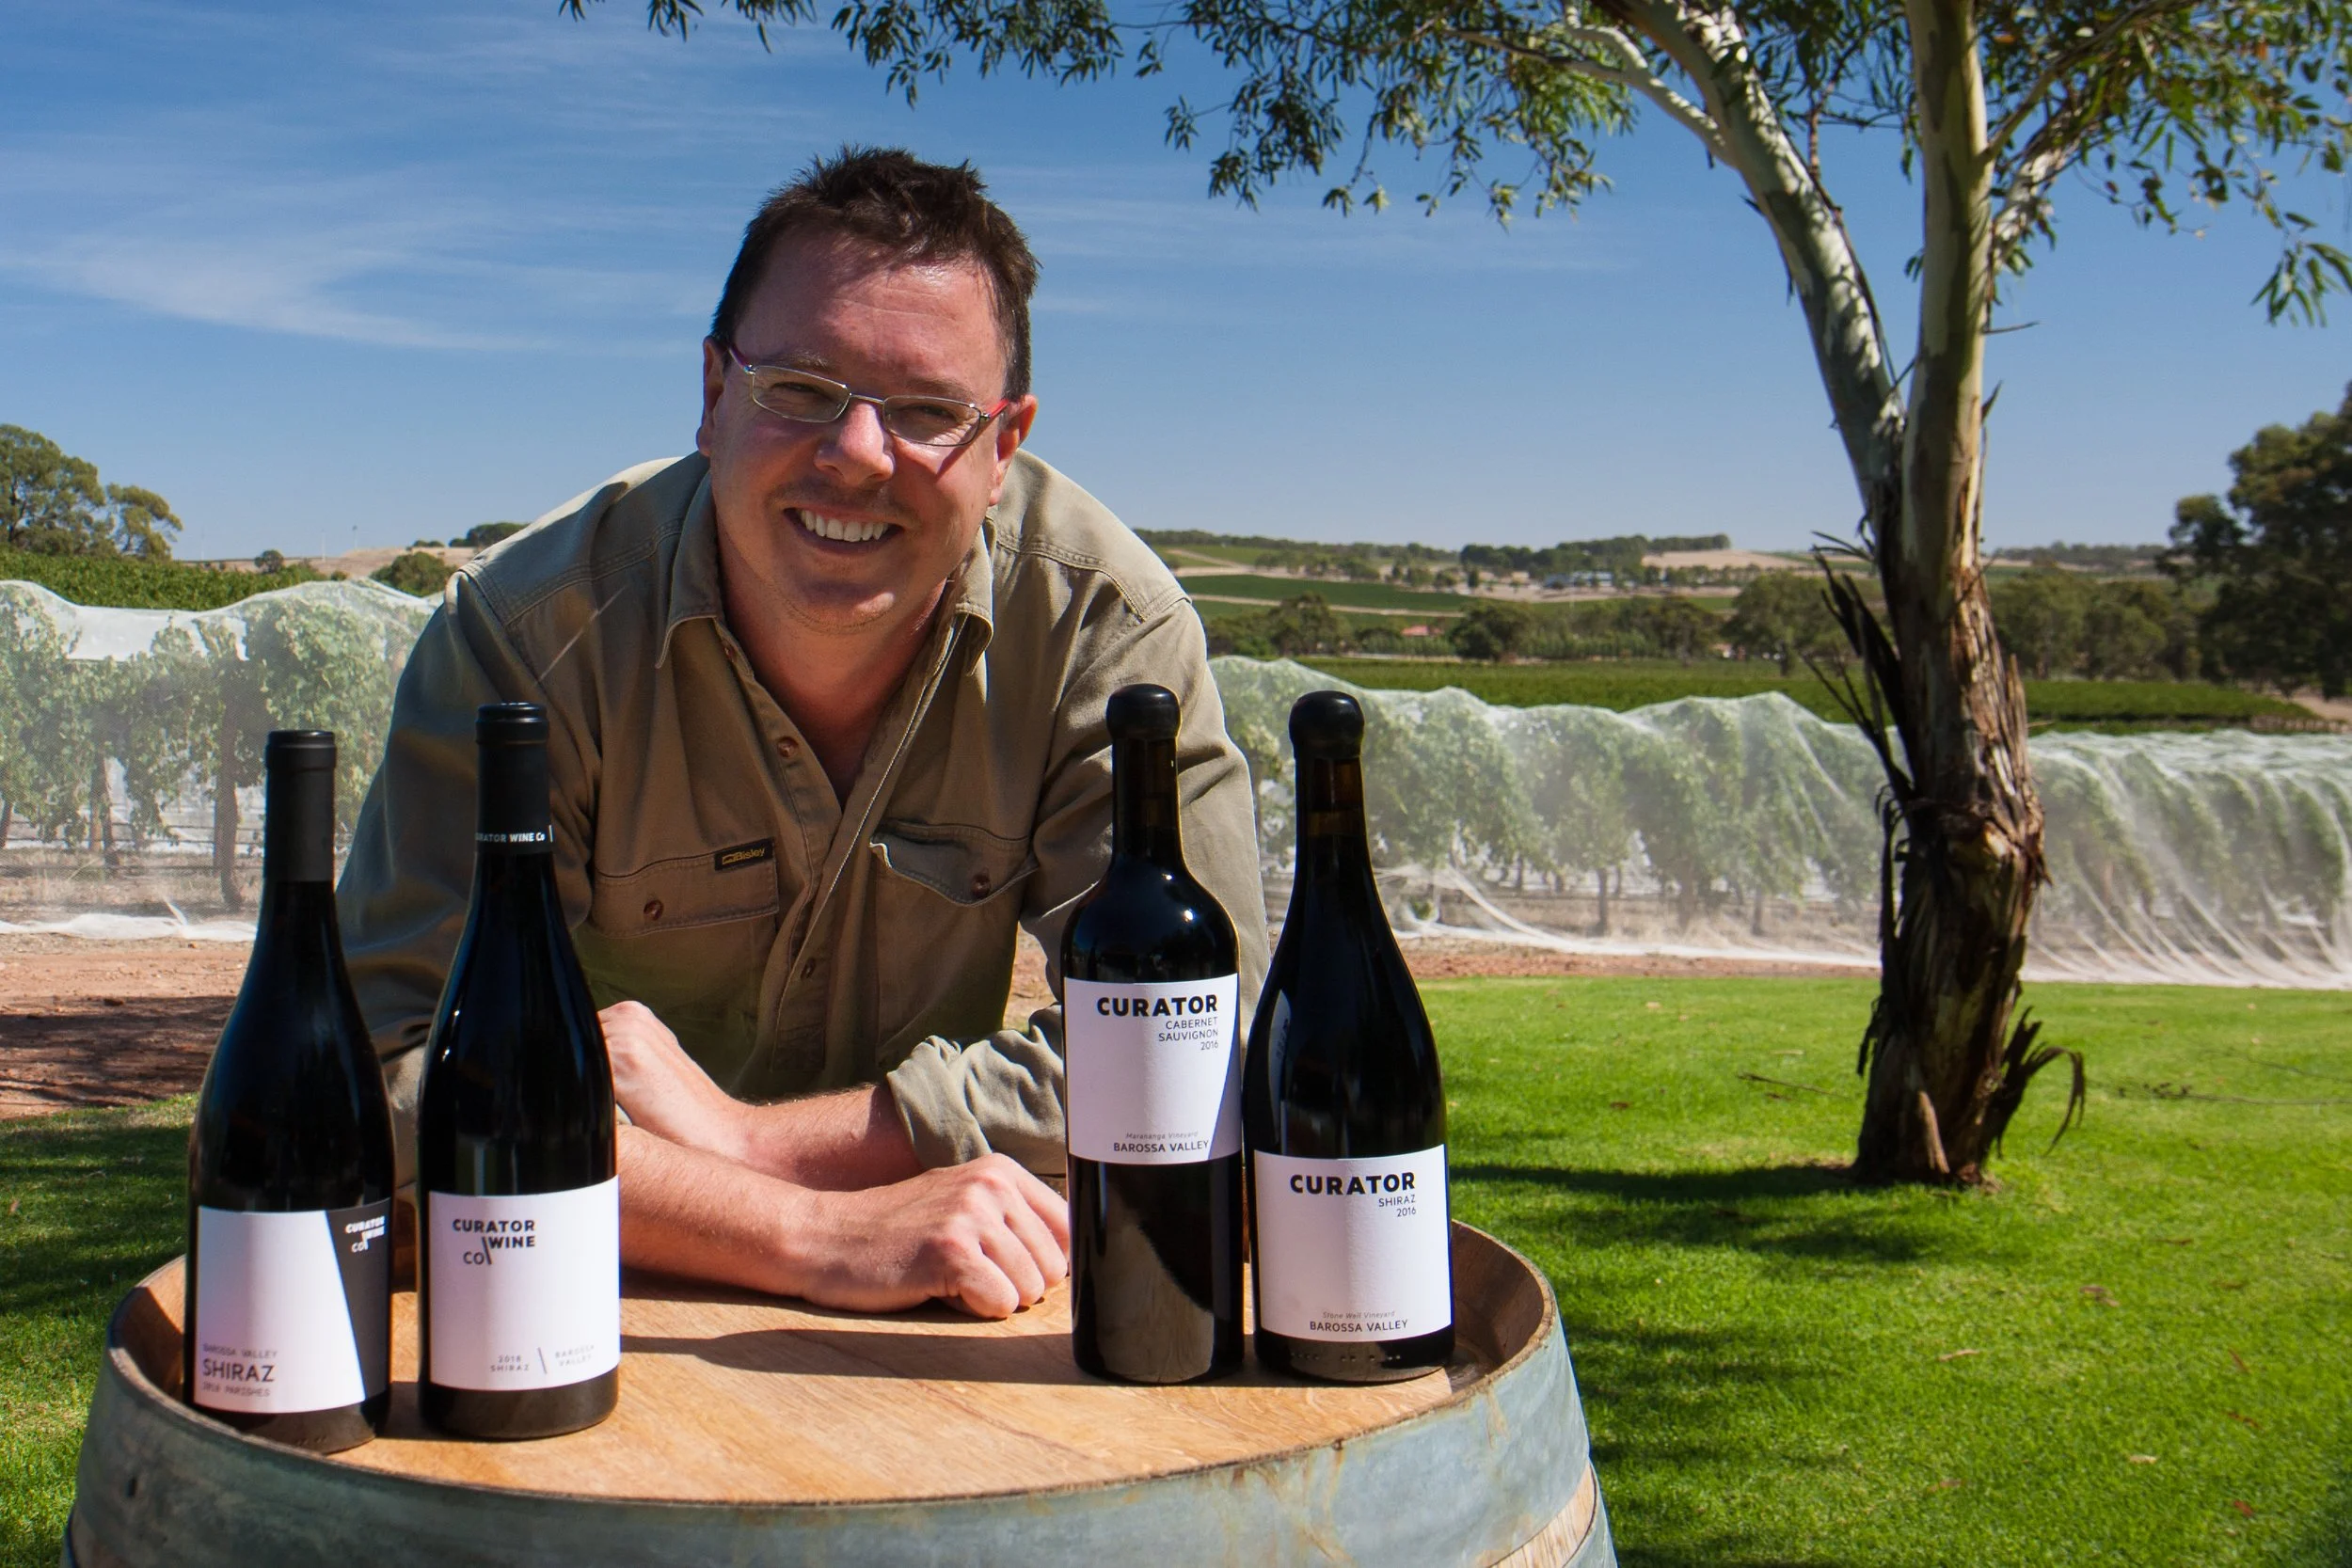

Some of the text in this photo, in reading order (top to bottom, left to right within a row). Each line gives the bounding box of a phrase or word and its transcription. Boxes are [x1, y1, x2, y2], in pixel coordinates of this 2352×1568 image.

[509, 832, 535, 843] WINE
[736, 848, 765, 861] Bisley
[1097, 994, 1218, 1017] CURATOR
[1166, 1017, 1218, 1030] CABERNET
[1158, 1029, 1219, 1042] SAUVIGNON
[1200, 1040, 1219, 1051] 2016
[1113, 1140, 1210, 1153] BAROSSA VALLEY
[1290, 1172, 1415, 1196] CURATOR
[1378, 1195, 1416, 1207] SHIRAZ
[1397, 1207, 1417, 1217] 2016
[345, 1215, 386, 1233] CURATOR
[453, 1219, 535, 1232] CURATOR
[488, 1235, 535, 1248] WINE
[463, 1251, 485, 1265] CO
[1363, 1310, 1395, 1319] Vineyard
[1310, 1319, 1408, 1333] BAROSSA VALLEY
[241, 1349, 278, 1359] VALLEY
[202, 1357, 276, 1383] SHIRAZ
[490, 1364, 530, 1373] SHIRAZ
